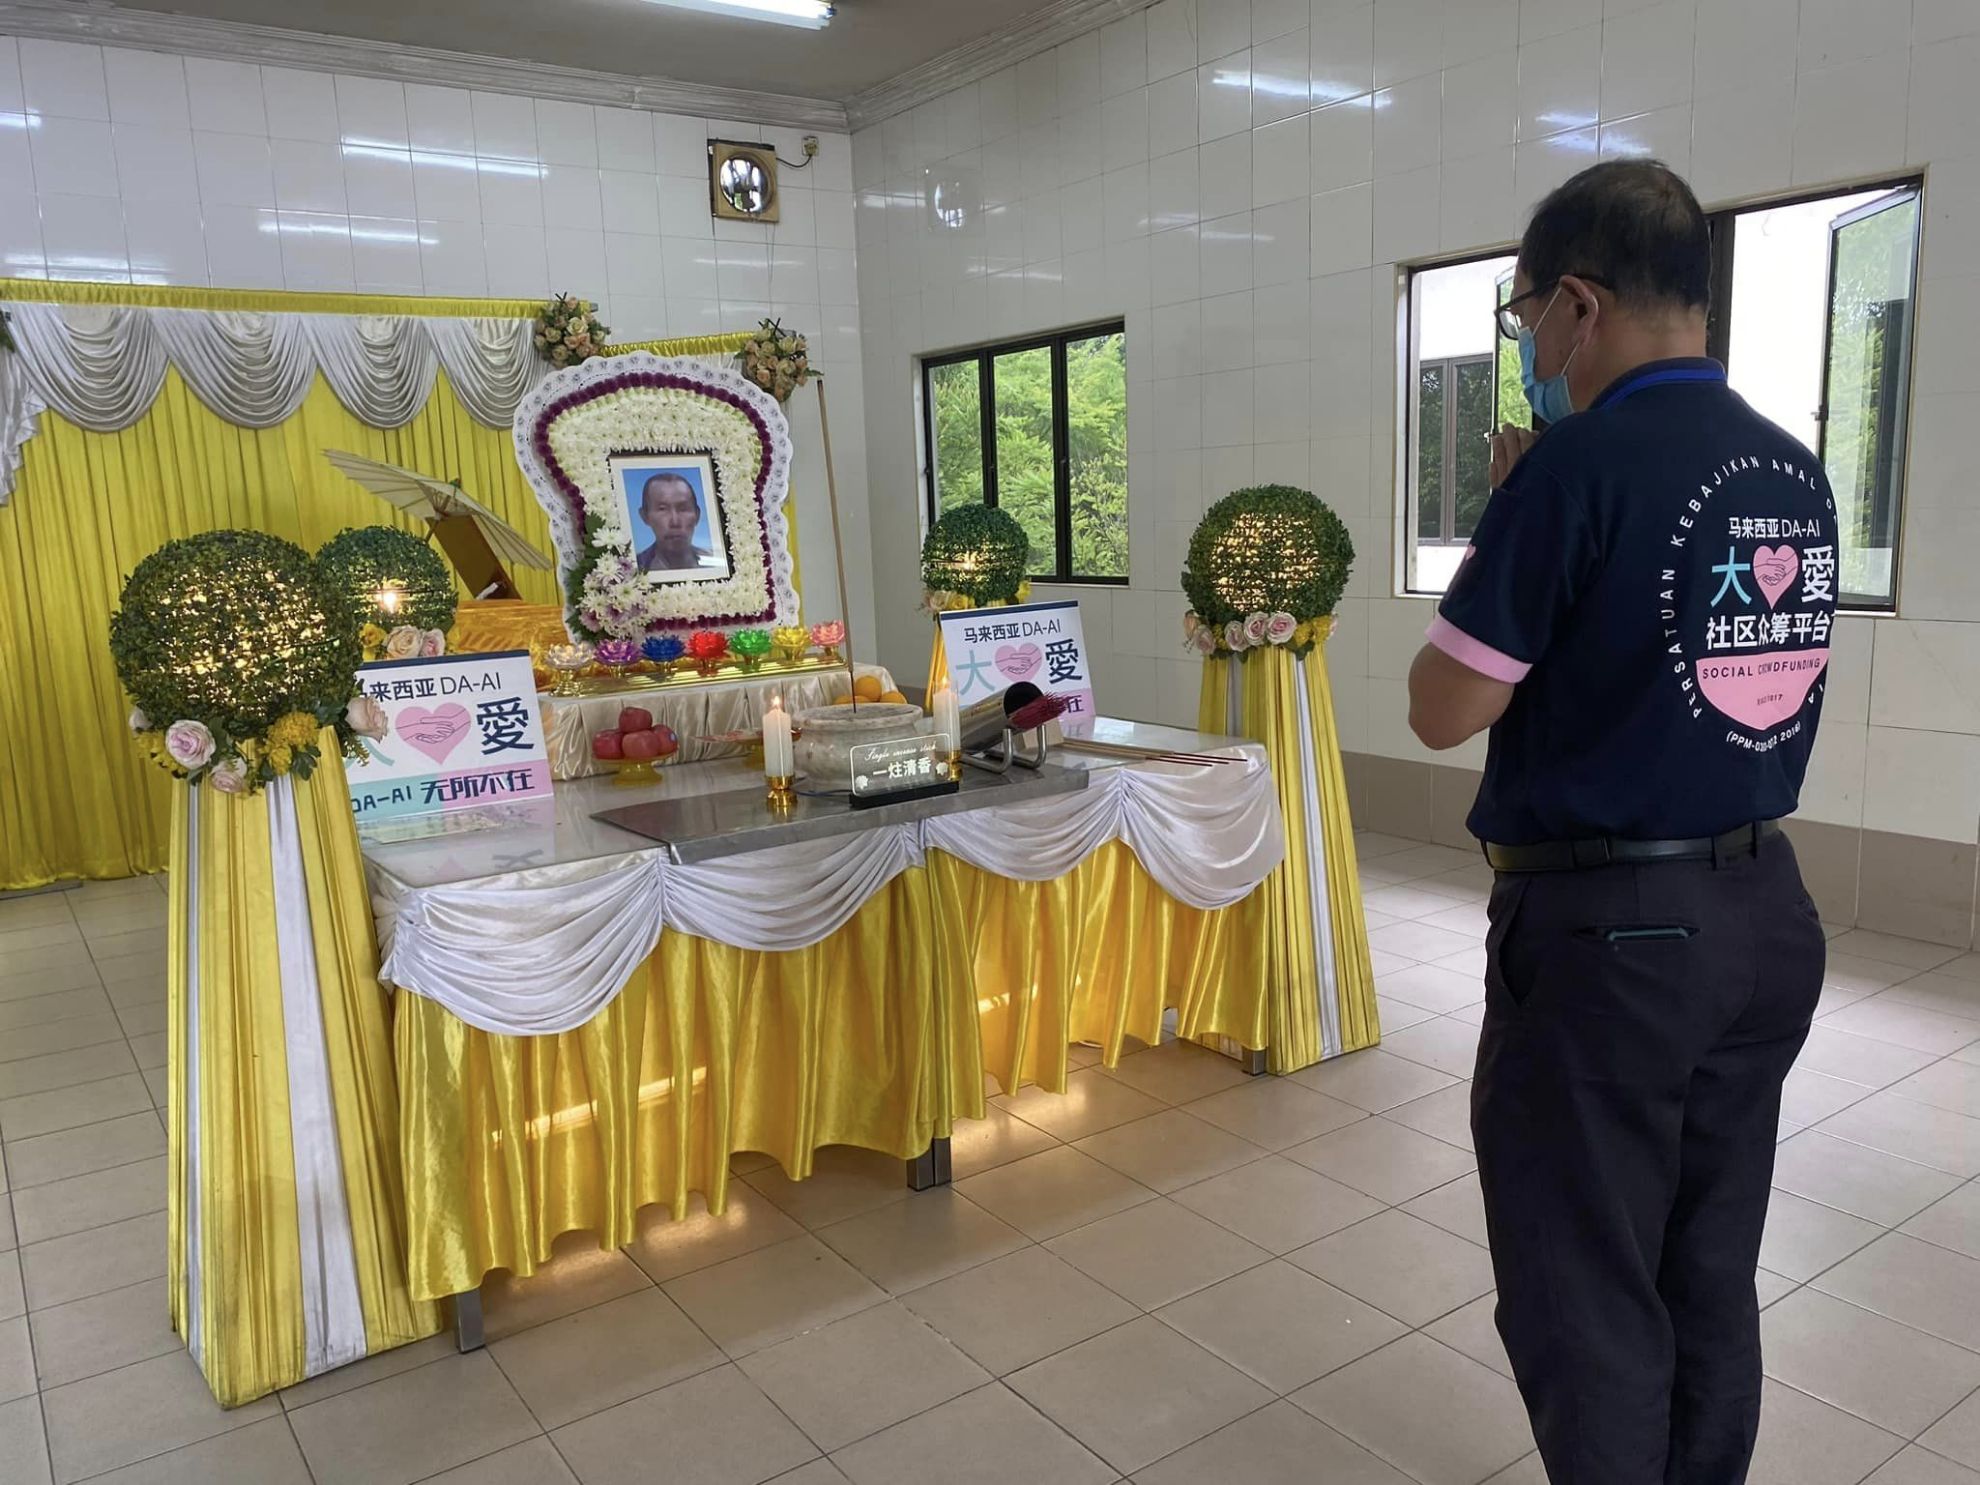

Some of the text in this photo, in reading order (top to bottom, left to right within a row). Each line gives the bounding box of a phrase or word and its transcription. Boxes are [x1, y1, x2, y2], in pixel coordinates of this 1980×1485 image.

[1728, 517, 1820, 539] 马来西亚 DA-AI
[1660, 456, 1816, 719] PERSATUAN KEBAJIKAN AMAL
[1710, 545, 1834, 607] 大 愛
[964, 619, 1061, 643] 马来西亚 DA-AI
[1706, 610, 1831, 650] 社区众筹平台
[440, 672, 501, 695] DA-AI
[955, 638, 1082, 695] 大 愛
[1702, 666, 1753, 679] SOCIAL
[476, 697, 534, 755] 愛
[420, 768, 535, 804] 无所不在
